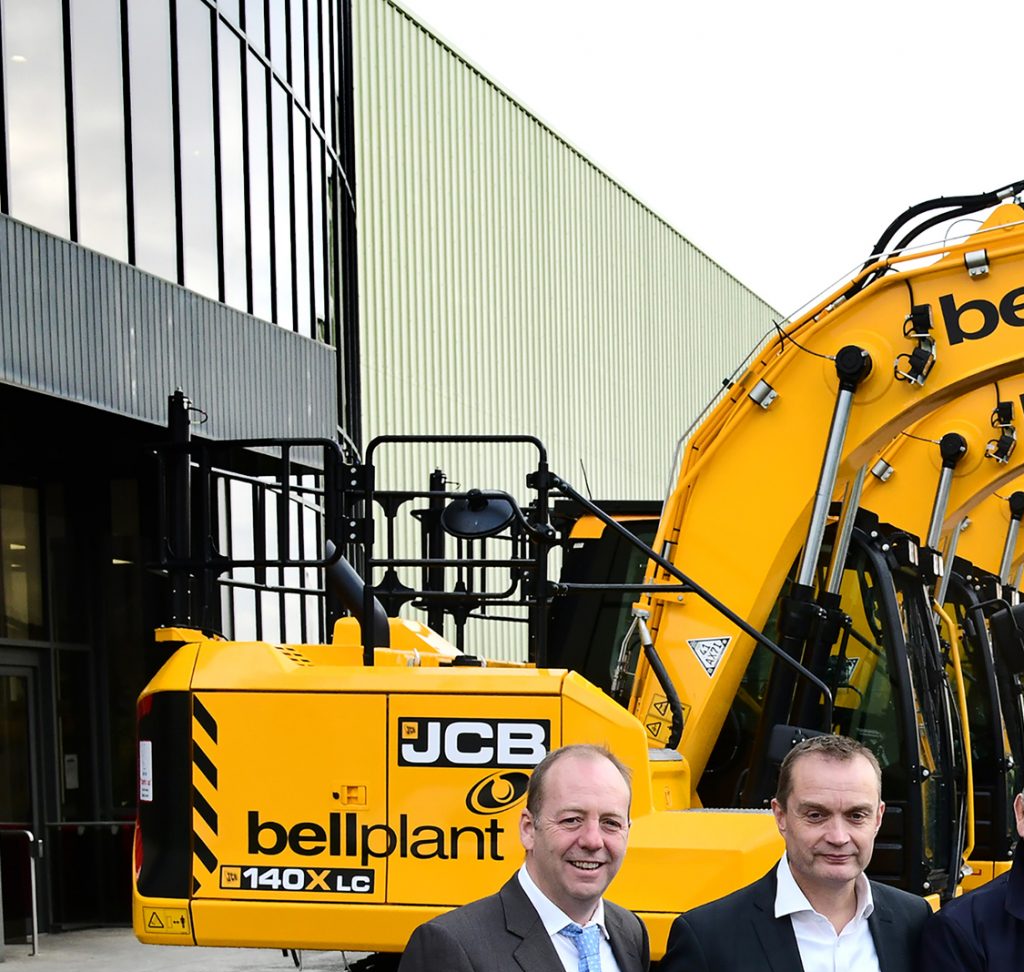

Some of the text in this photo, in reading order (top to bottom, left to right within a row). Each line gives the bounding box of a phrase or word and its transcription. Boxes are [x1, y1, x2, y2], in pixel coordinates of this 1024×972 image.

[401, 721, 547, 765] JCB
[247, 810, 505, 867] bellplant
[243, 867, 371, 893] 140X LC
